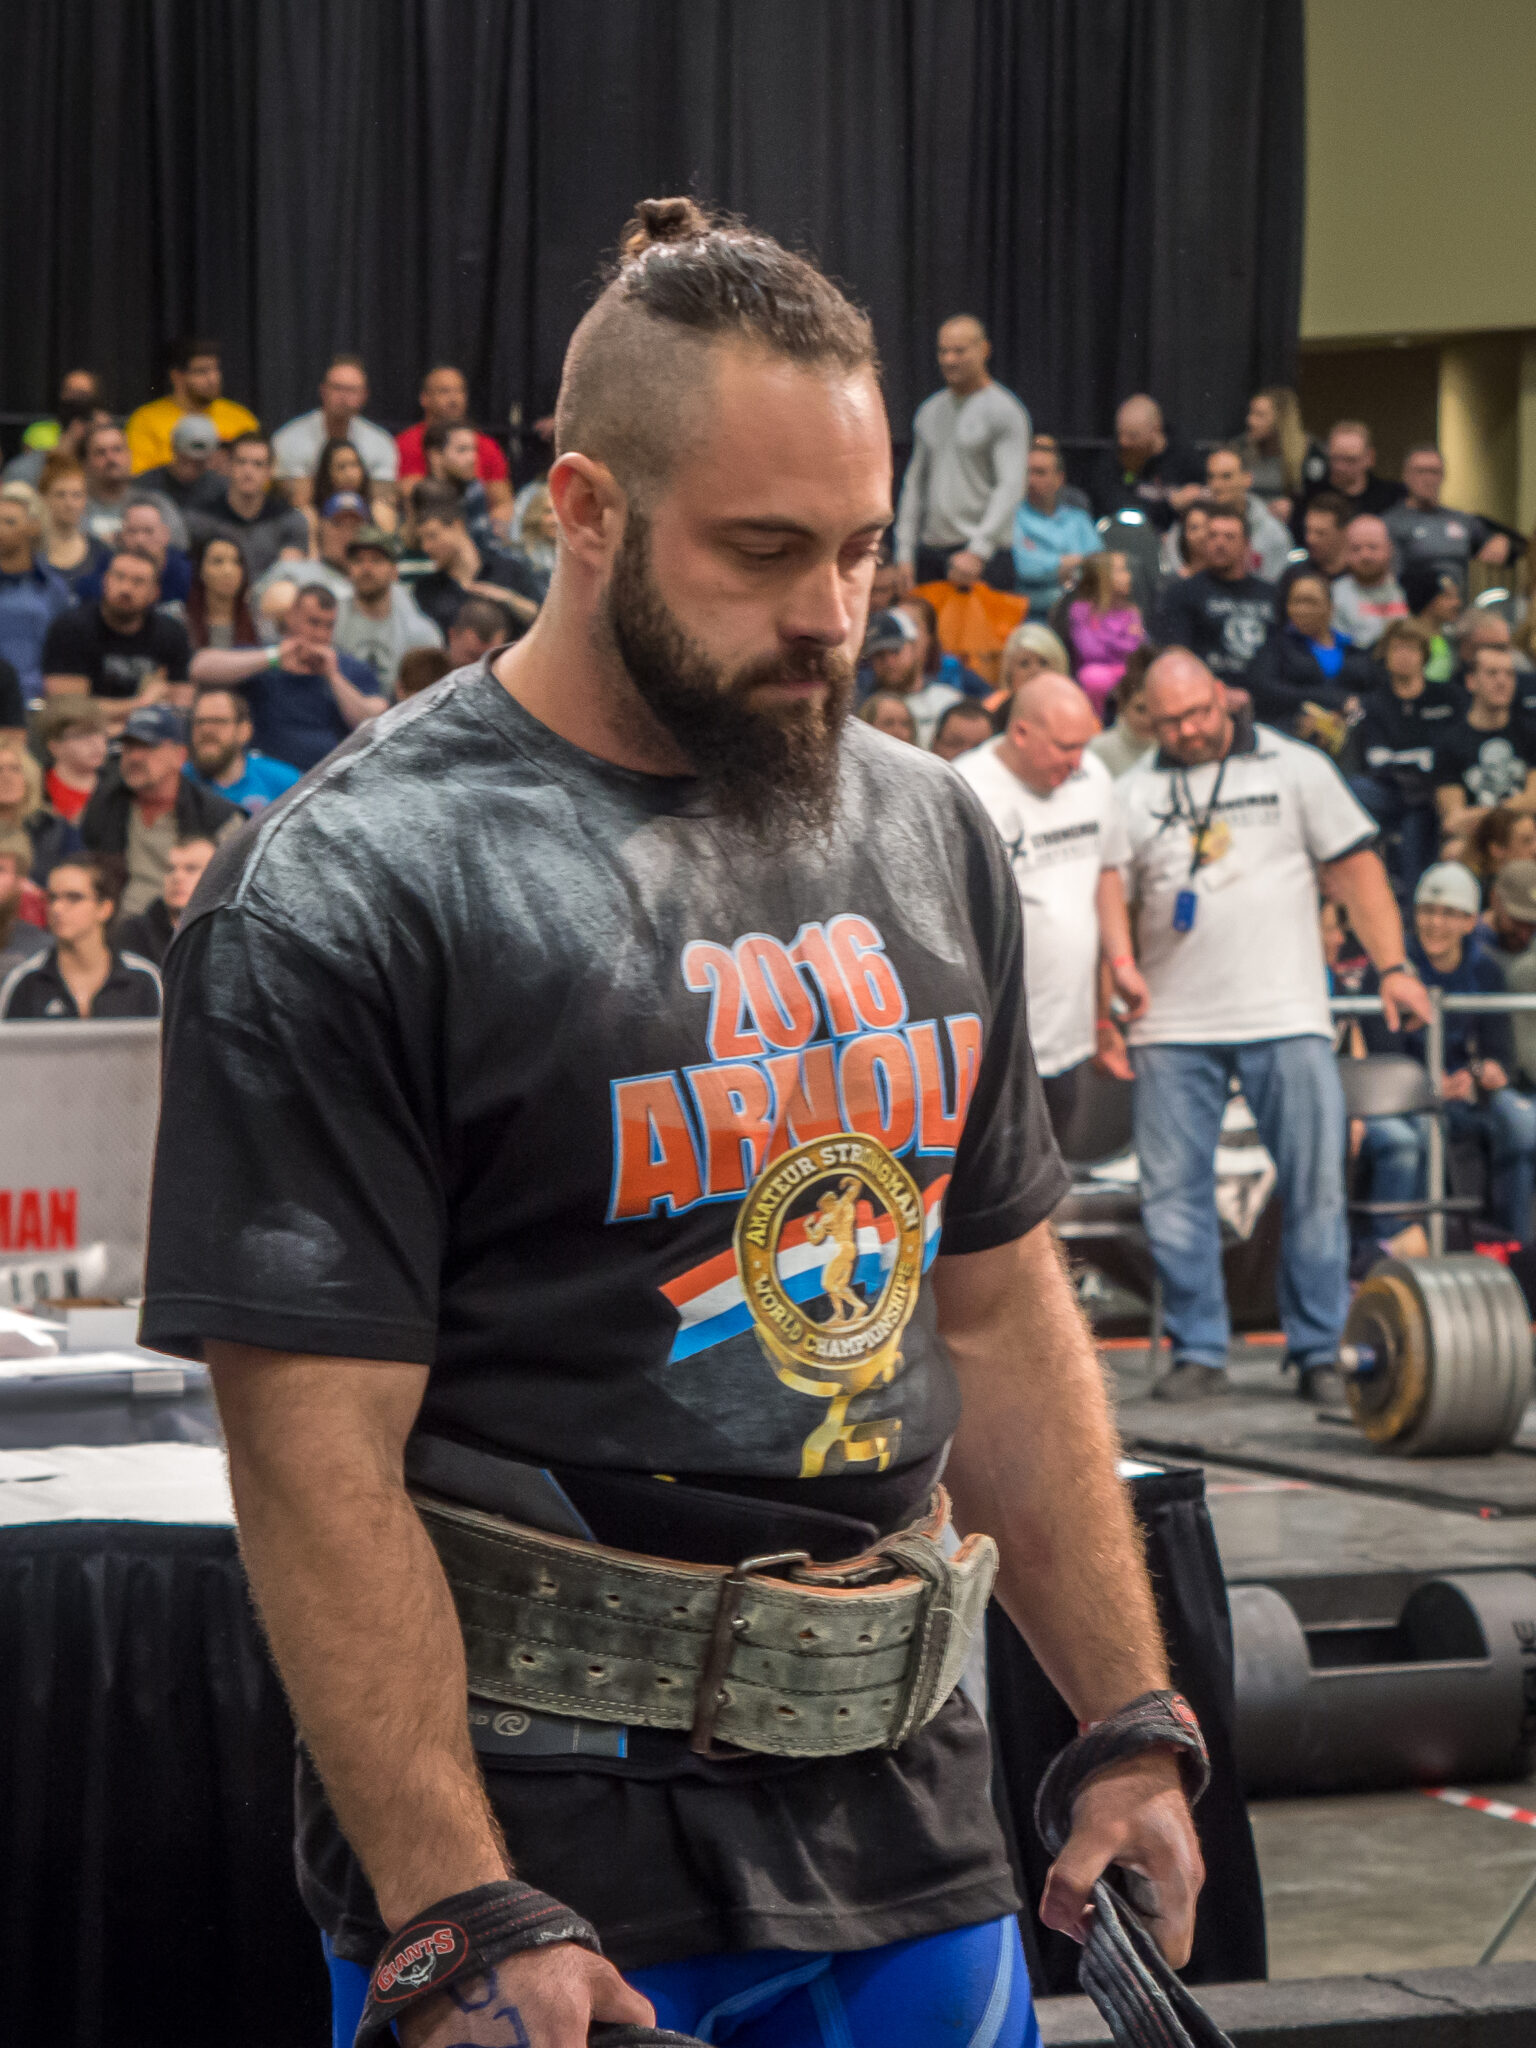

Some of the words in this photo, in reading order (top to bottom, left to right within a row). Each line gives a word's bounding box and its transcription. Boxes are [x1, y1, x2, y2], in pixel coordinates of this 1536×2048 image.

[681, 913, 908, 1062] 2016
[746, 1157, 818, 1247] AMATEUR
[819, 1143, 919, 1231] STRGMAN
[753, 1273, 804, 1343] WORLD
[377, 1928, 455, 1991] GIANTS
